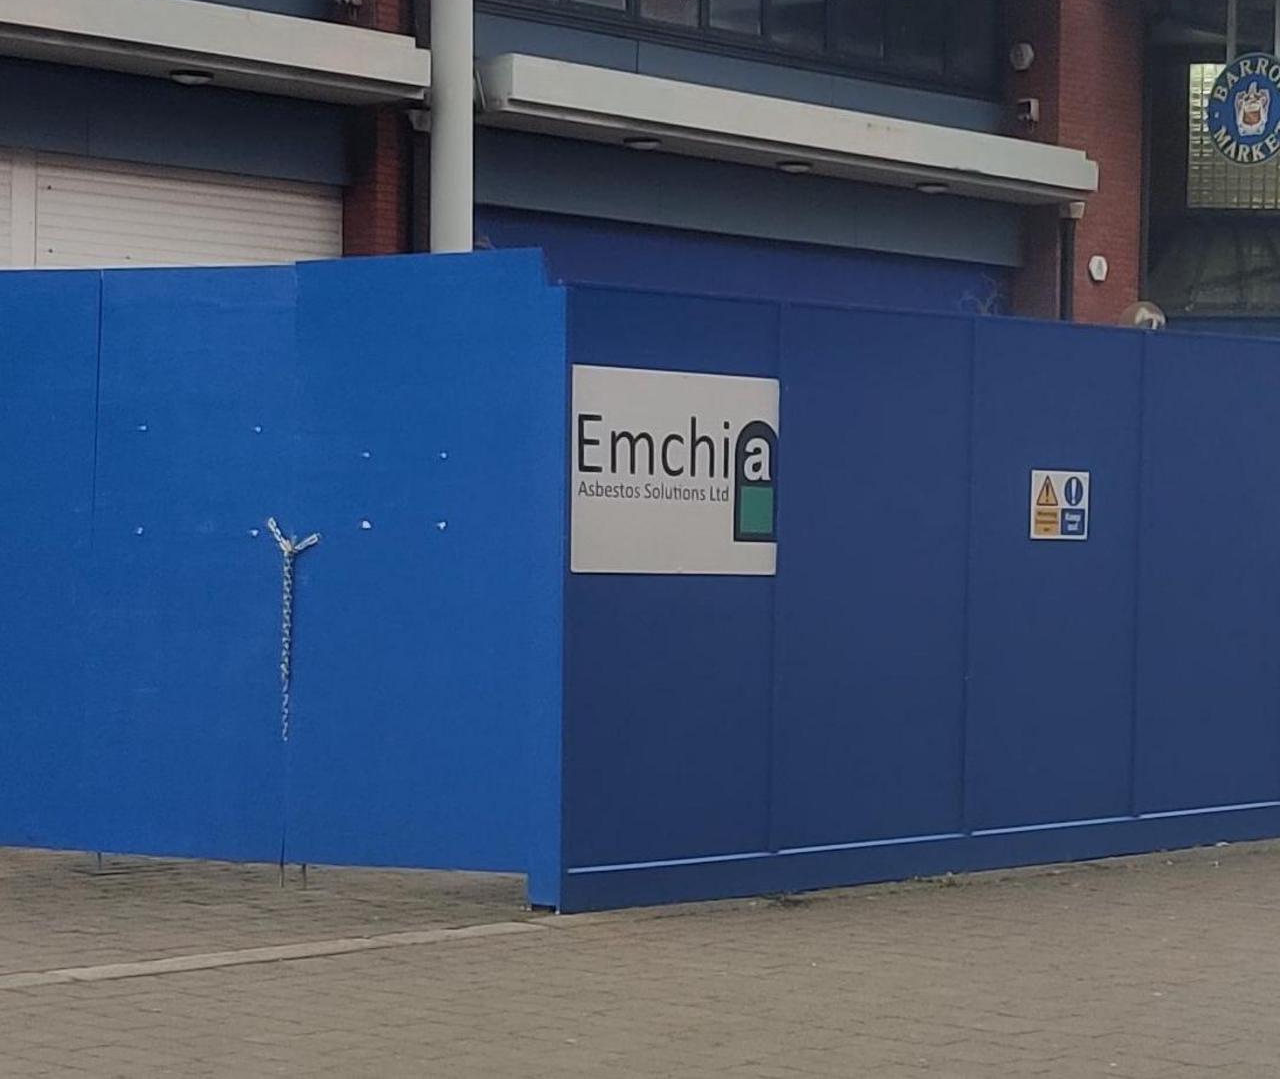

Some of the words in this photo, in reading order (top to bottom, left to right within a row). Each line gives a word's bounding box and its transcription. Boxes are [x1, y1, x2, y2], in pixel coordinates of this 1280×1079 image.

[577, 413, 775, 481] Emchia
[578, 481, 641, 499] Asbestos
[644, 483, 706, 501] Solutions
[709, 485, 730, 502] Ltd
